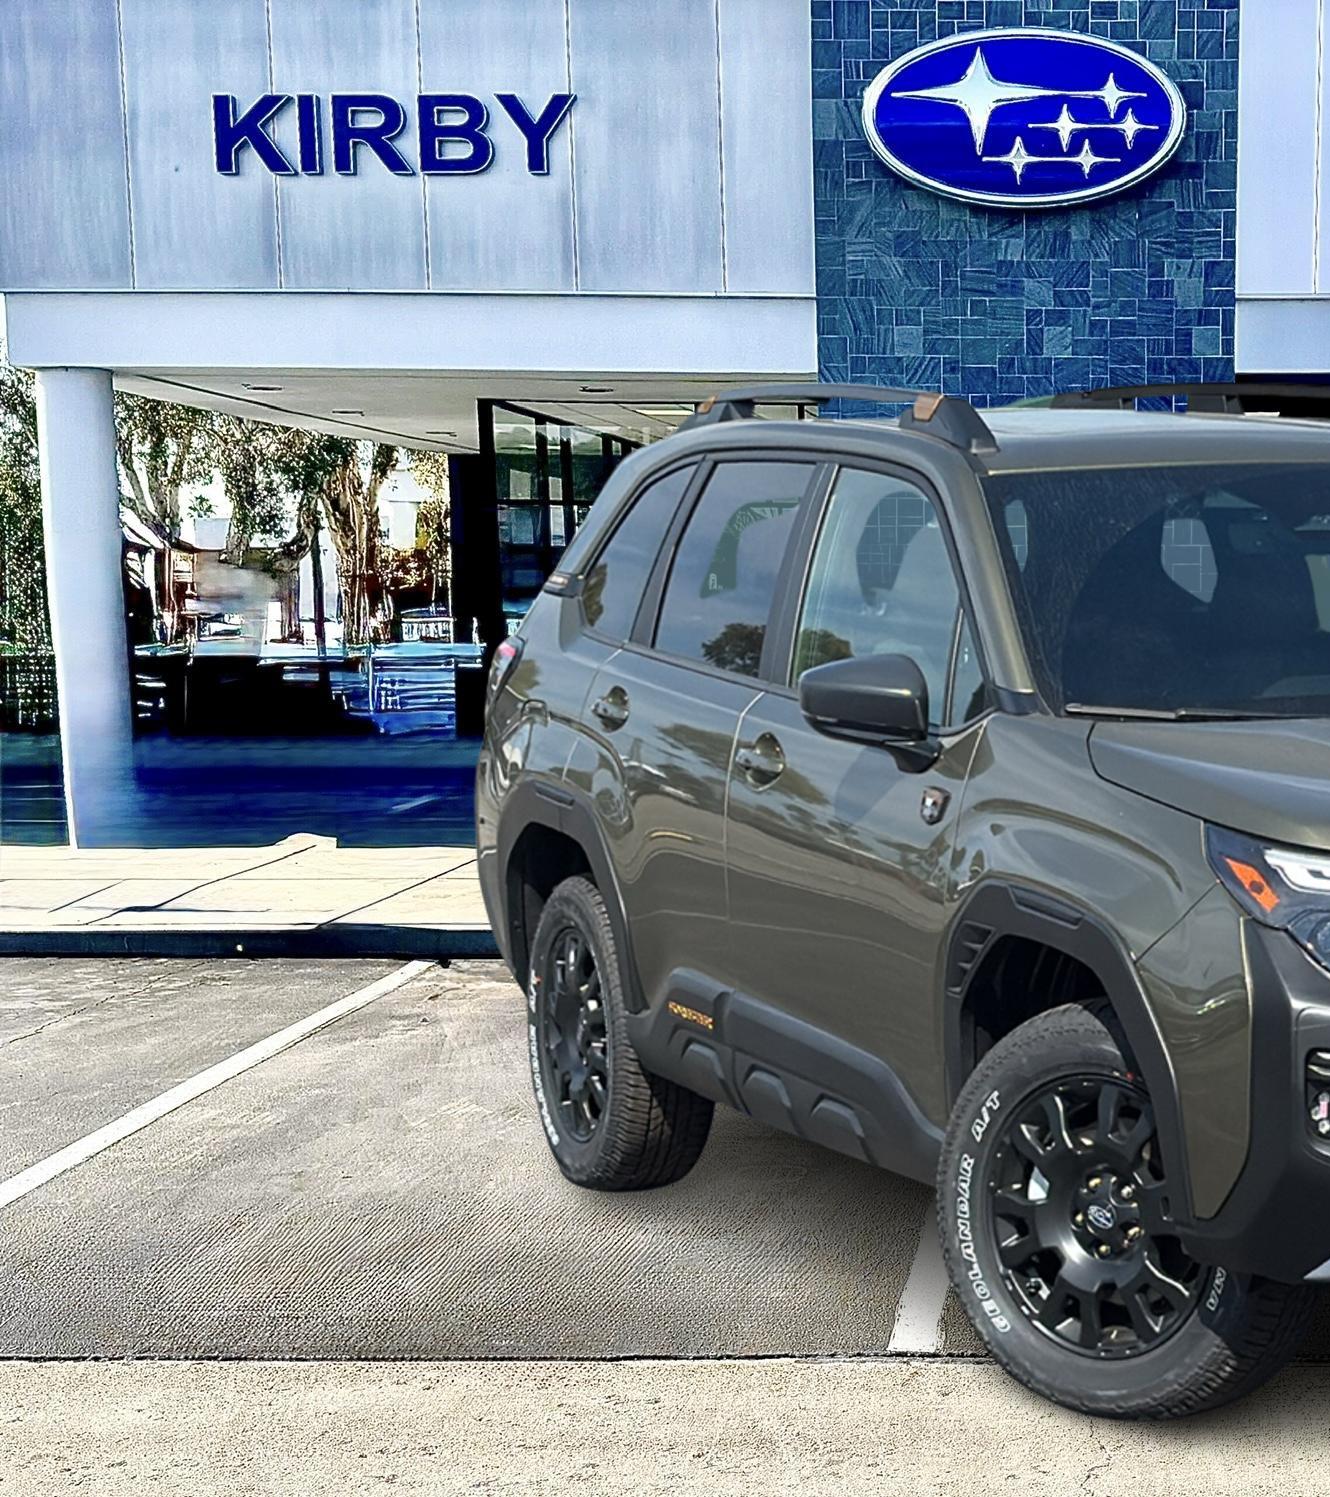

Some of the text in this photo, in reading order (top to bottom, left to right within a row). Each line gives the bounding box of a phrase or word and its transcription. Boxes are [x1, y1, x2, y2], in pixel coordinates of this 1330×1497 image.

[211, 93, 577, 176] KIRBY
[957, 1090, 1011, 1333] GEOLANDAR A/T
